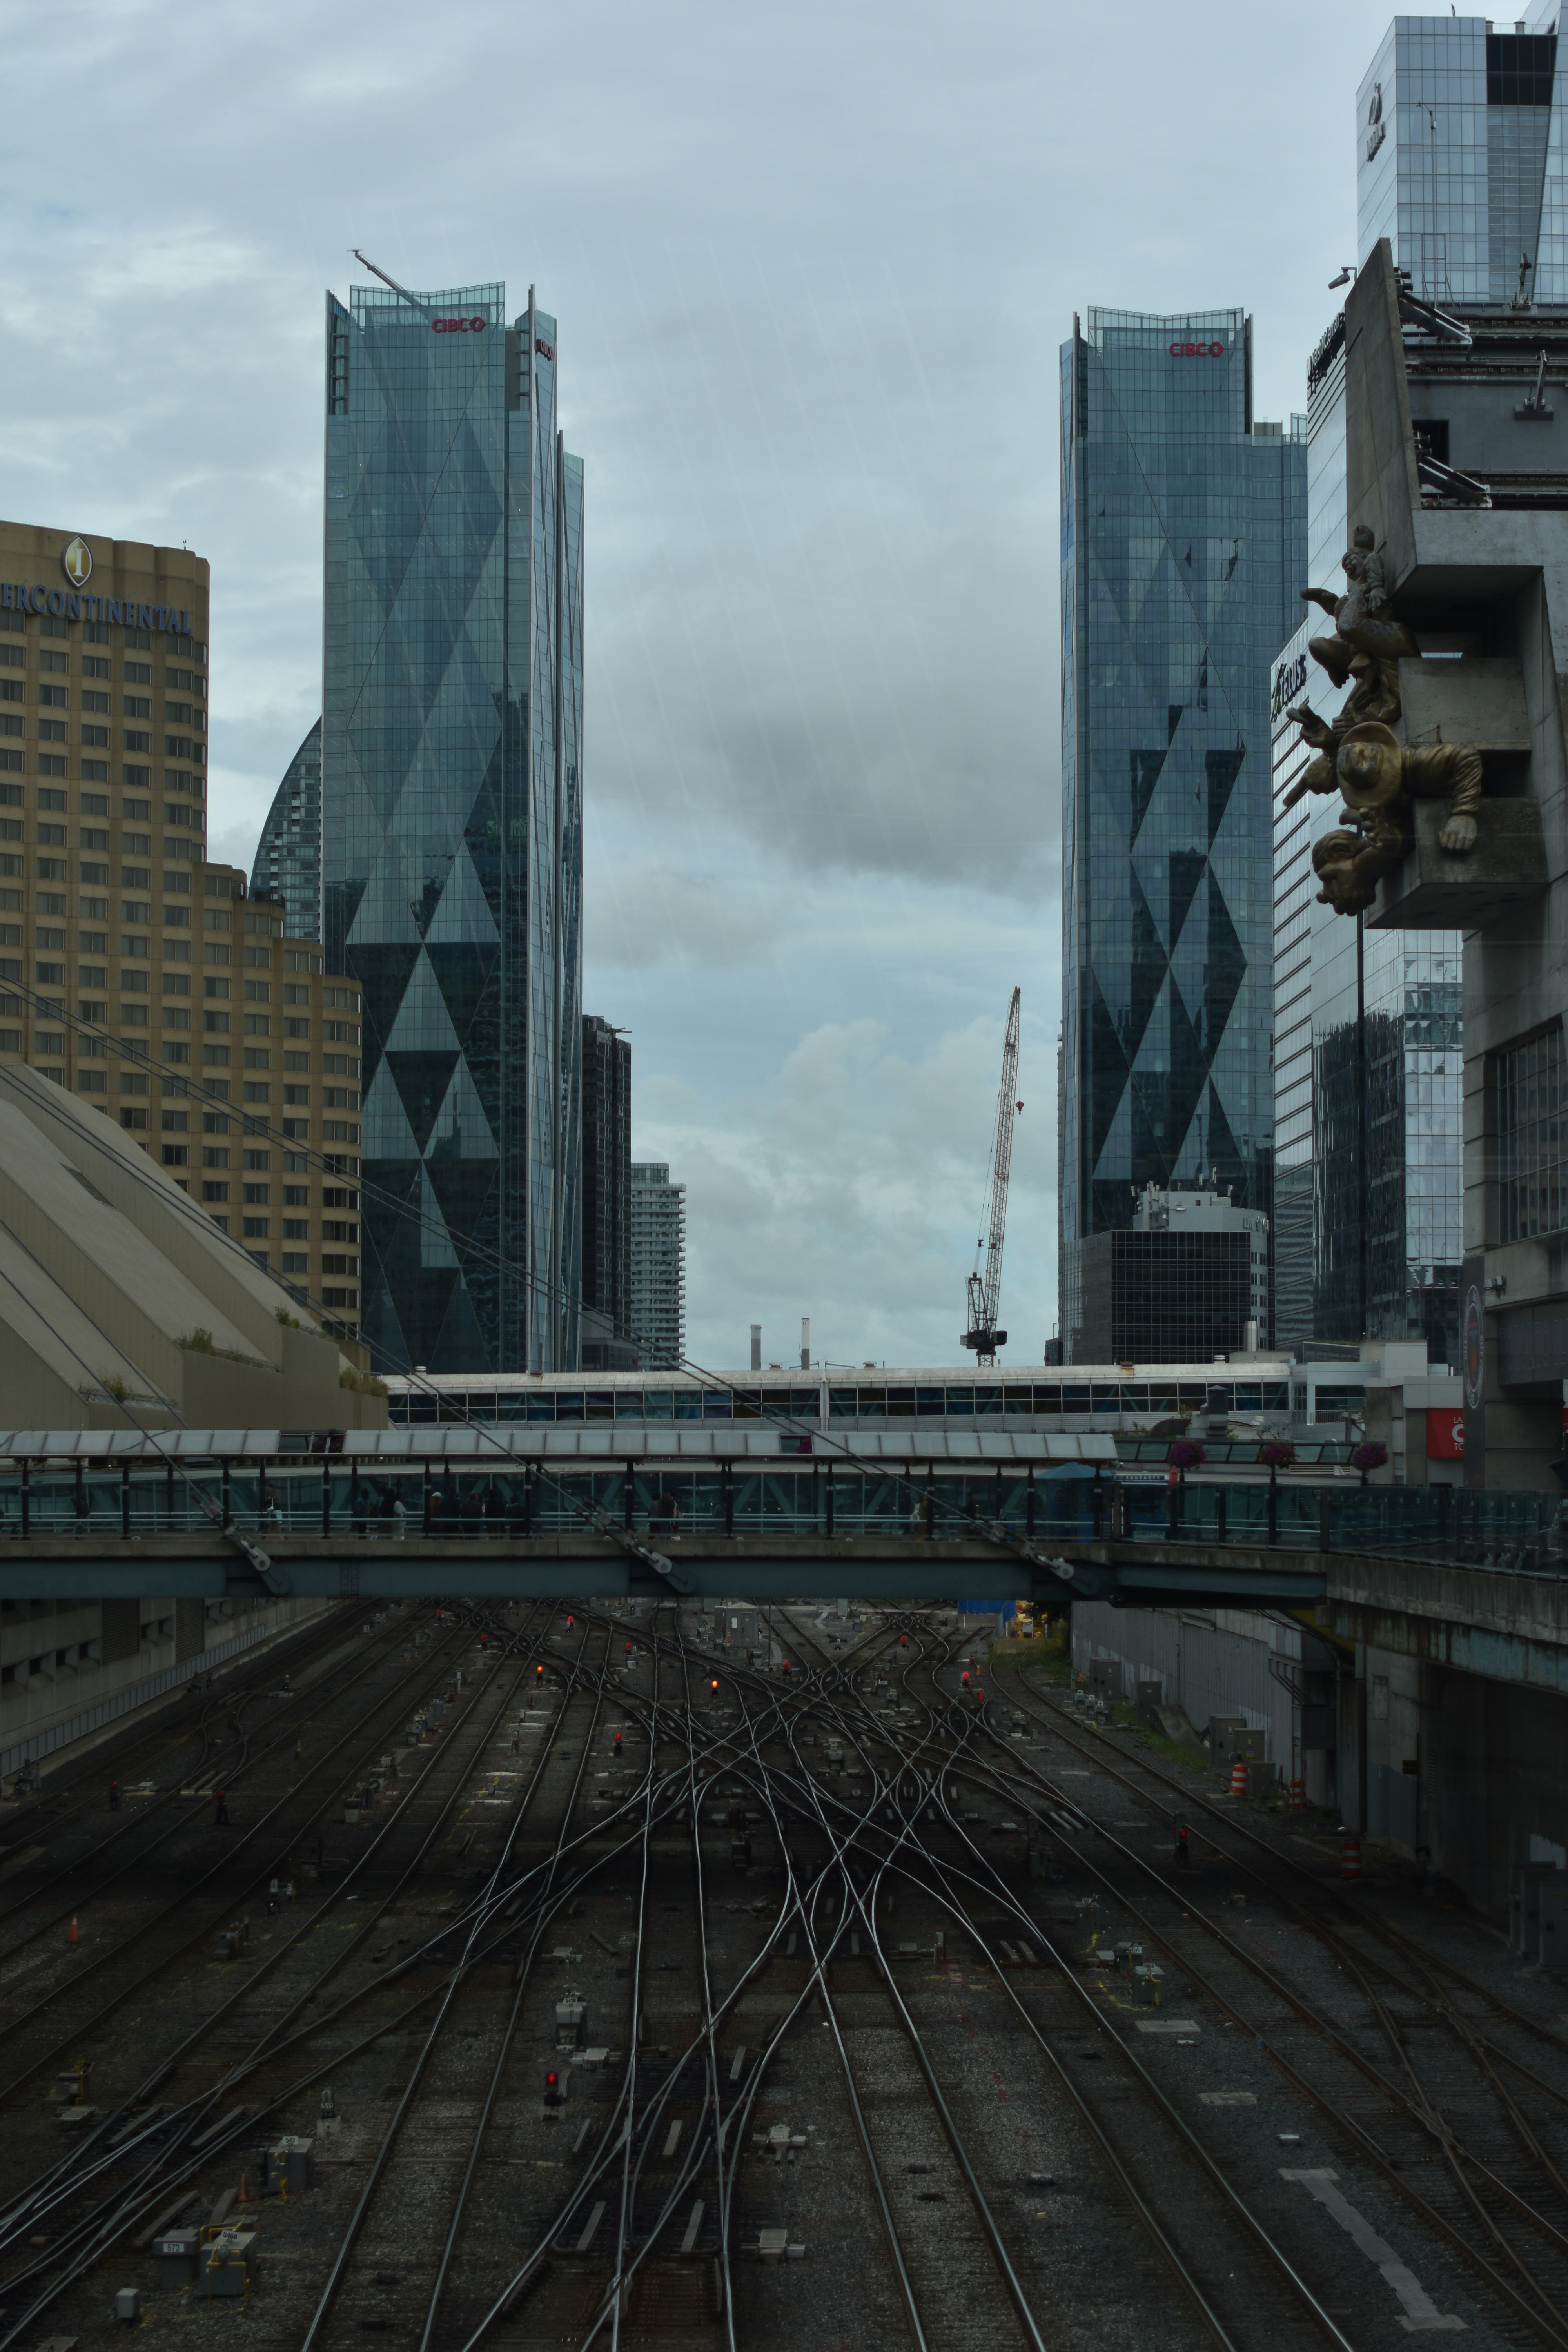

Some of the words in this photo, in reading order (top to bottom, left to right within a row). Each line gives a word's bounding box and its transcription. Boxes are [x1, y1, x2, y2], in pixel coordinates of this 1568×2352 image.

[432, 318, 468, 333] CIBC
[1169, 342, 1207, 357] CIBC
[0, 582, 192, 635] ERCONTINENTAL
[1279, 654, 1306, 706] TELUS
[223, 2232, 237, 2240] 546A
